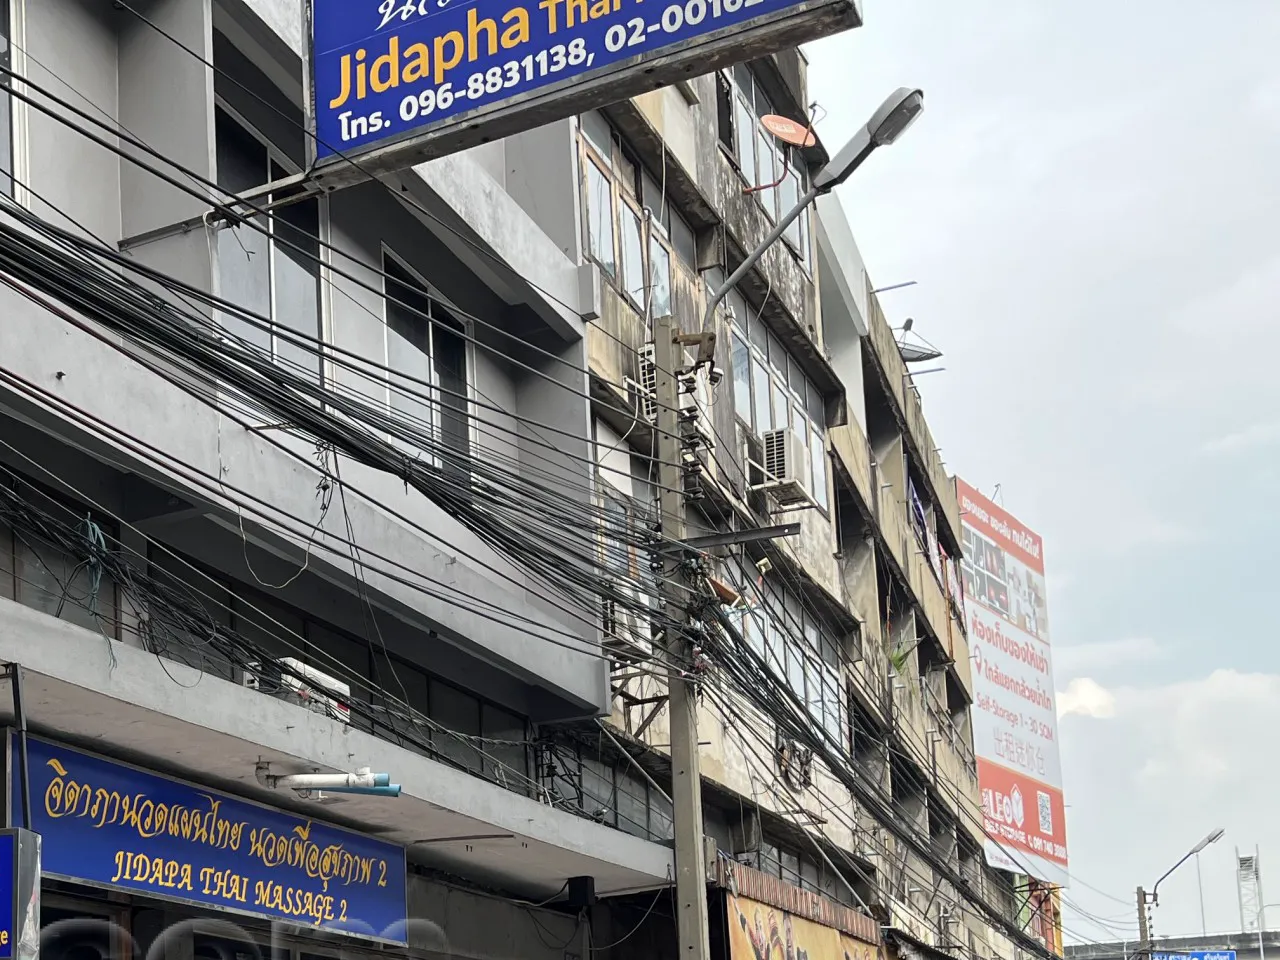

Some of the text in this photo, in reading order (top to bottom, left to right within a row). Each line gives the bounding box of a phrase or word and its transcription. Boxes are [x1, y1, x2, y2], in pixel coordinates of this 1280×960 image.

[329, 6, 530, 109] Jidapha
[539, 0, 621, 34] Tha
[338, 0, 764, 142] โทร. 096-8831138, 02-001
[976, 692, 1019, 728] Self-Storage
[111, 851, 348, 925] JIDAPA THAI MASSAGE 2
[377, 860, 388, 887] 2
